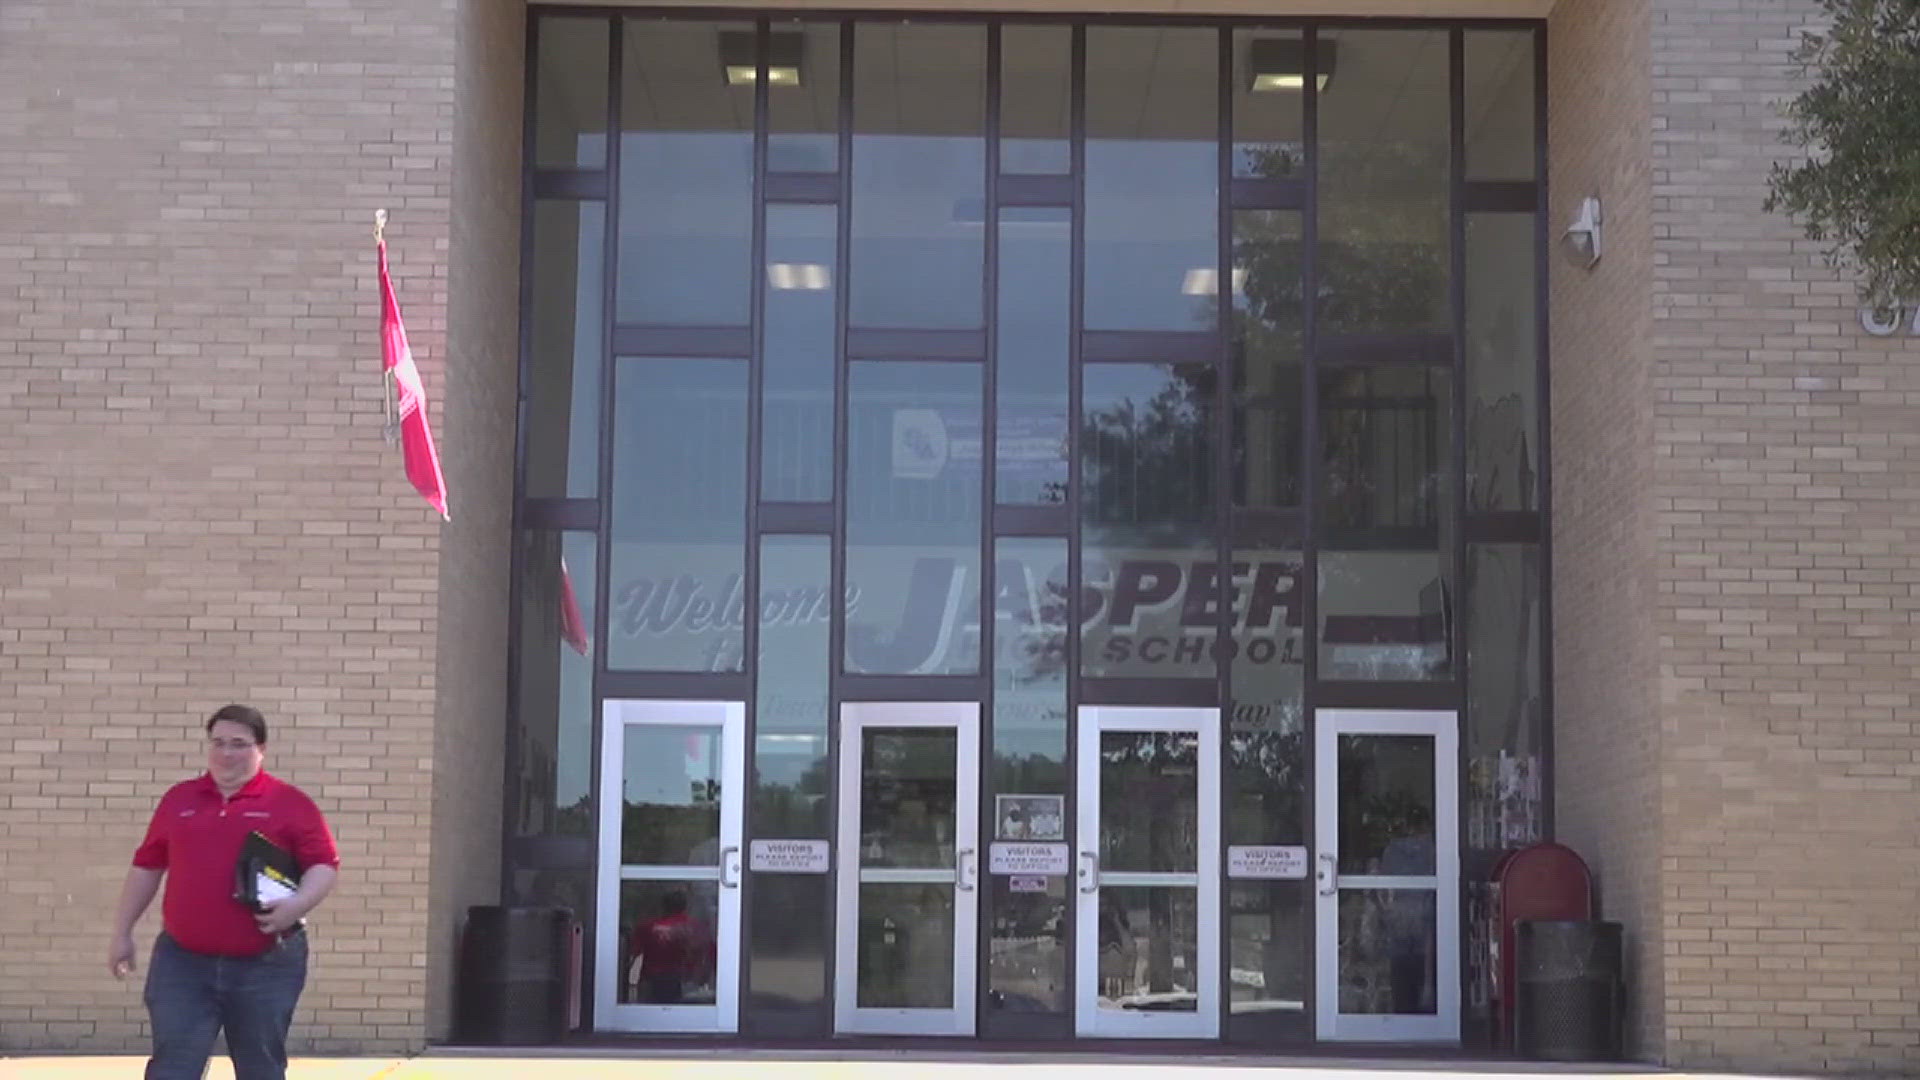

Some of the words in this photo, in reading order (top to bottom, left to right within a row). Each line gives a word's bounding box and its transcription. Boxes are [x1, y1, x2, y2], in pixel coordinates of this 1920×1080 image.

[848, 557, 1322, 673] JASPER
[1103, 634, 1305, 665] SCHOOL
[767, 844, 814, 855] VISITORS
[1005, 846, 1053, 857] VISITORS
[1244, 849, 1291, 860] VISITORS
